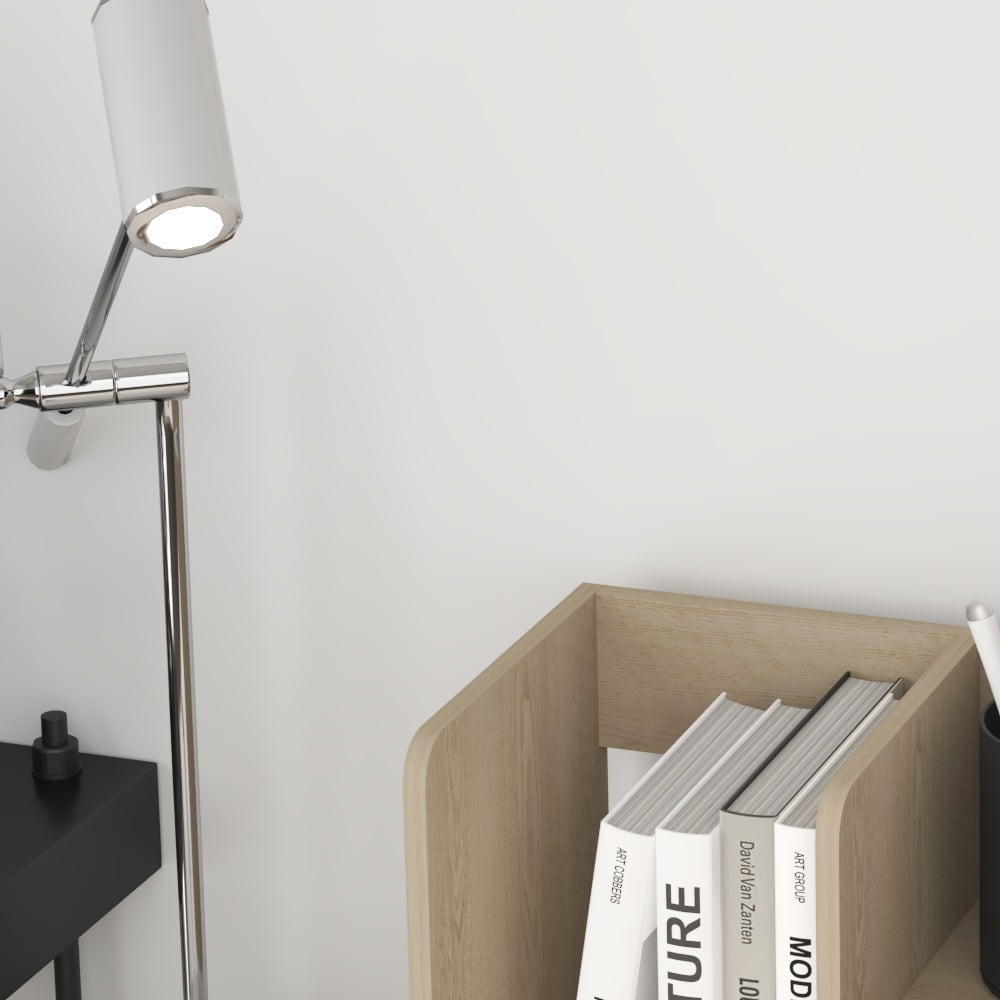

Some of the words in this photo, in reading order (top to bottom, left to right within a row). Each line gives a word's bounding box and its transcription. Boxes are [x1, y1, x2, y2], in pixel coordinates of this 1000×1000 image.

[615, 847, 628, 866] ART
[740, 840, 755, 876] David
[794, 851, 806, 870] ART
[609, 866, 625, 905] COBBERS
[740, 878, 755, 900] Van
[794, 871, 806, 904] GROUP
[740, 902, 756, 945] Zanten
